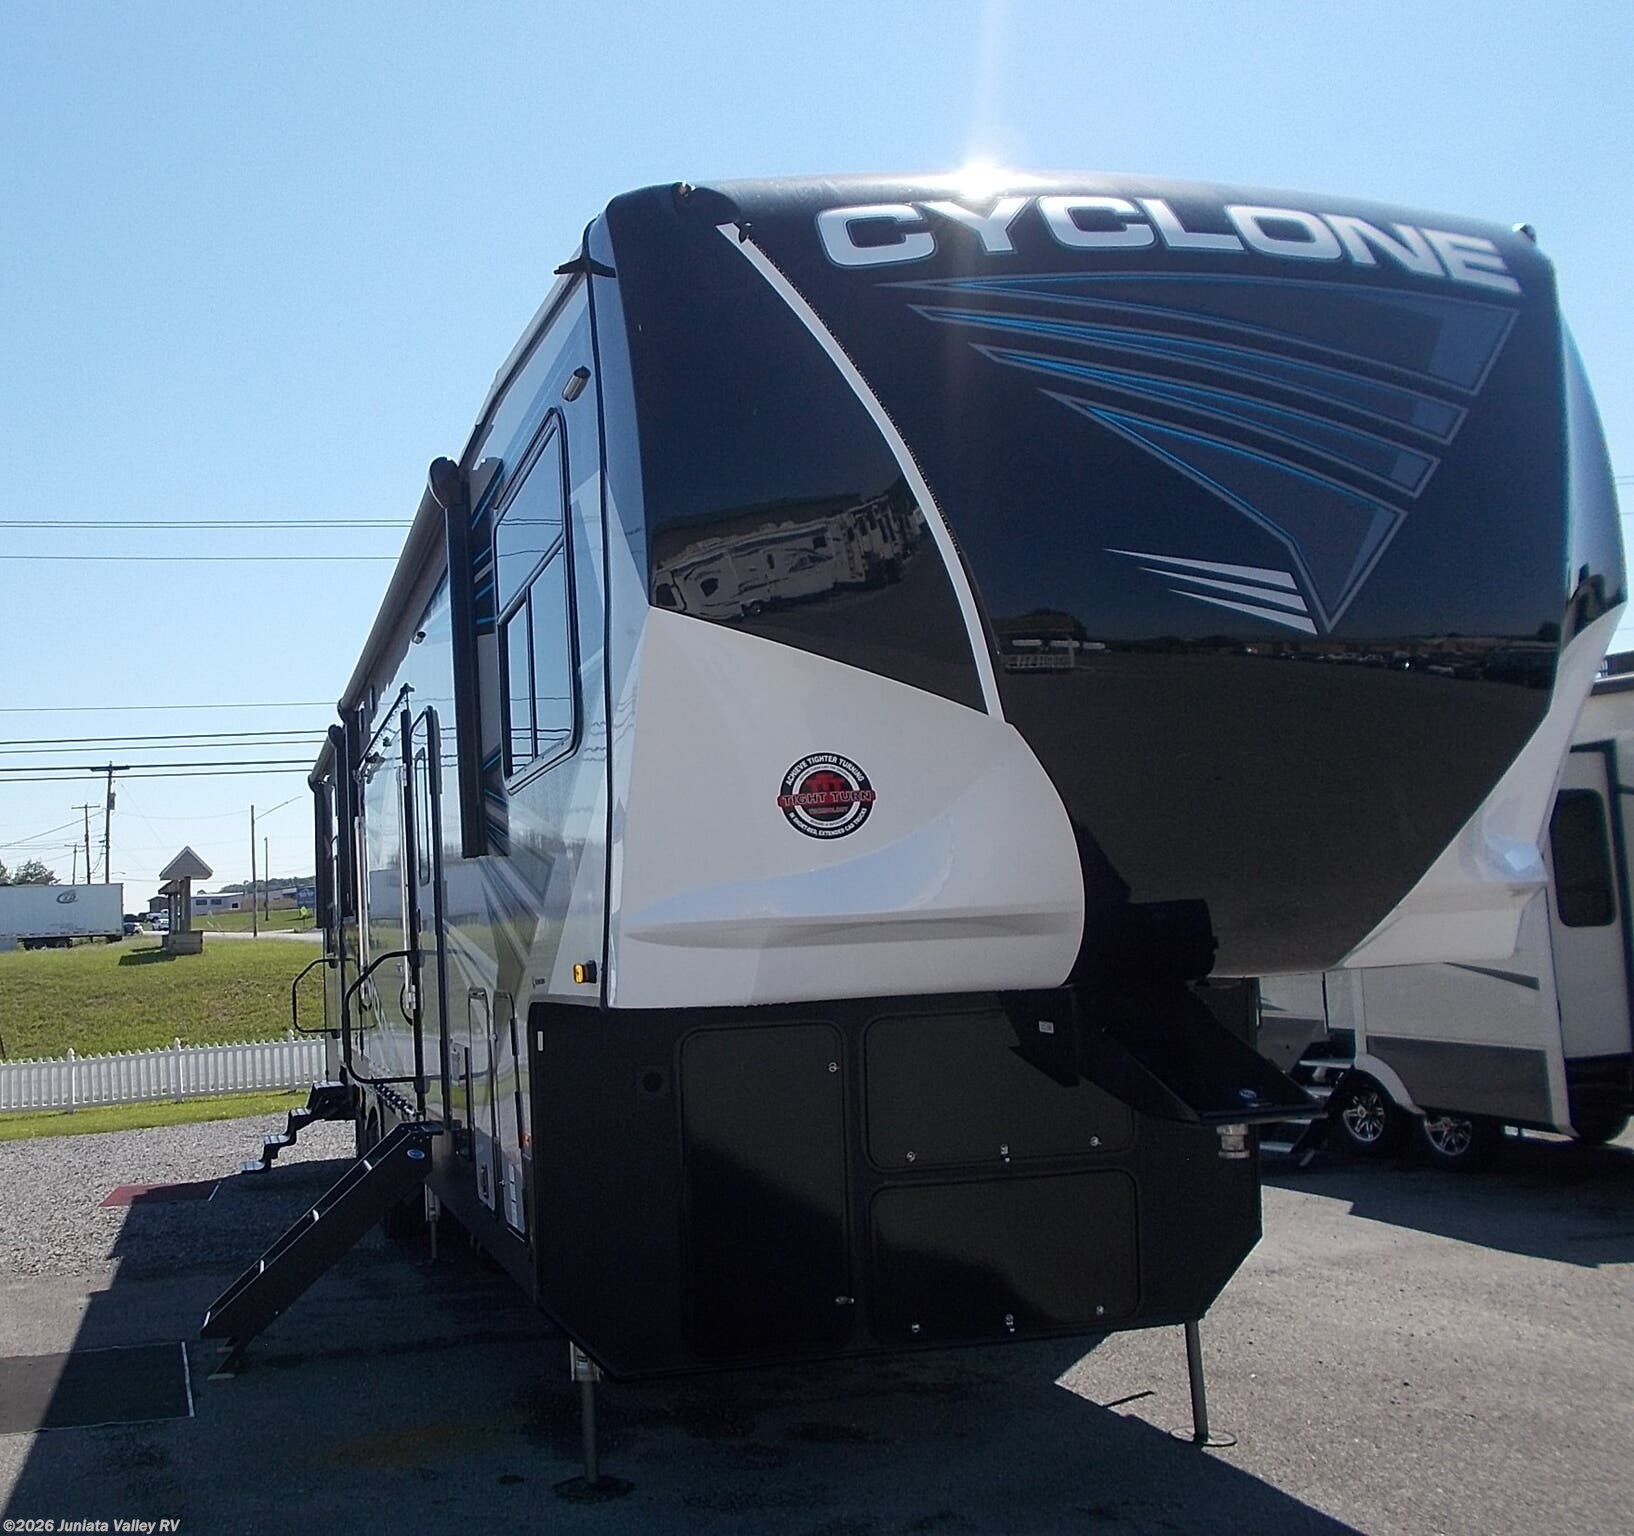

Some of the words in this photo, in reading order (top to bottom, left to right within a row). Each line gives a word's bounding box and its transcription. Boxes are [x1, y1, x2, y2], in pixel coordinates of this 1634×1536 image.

[814, 195, 1522, 293] CYCLONE
[786, 761, 808, 785] ACHIEVE
[807, 755, 837, 764] TIGHTER
[838, 759, 865, 781] TURNING
[783, 793, 826, 805] TIGHT
[831, 791, 871, 802] TURN
